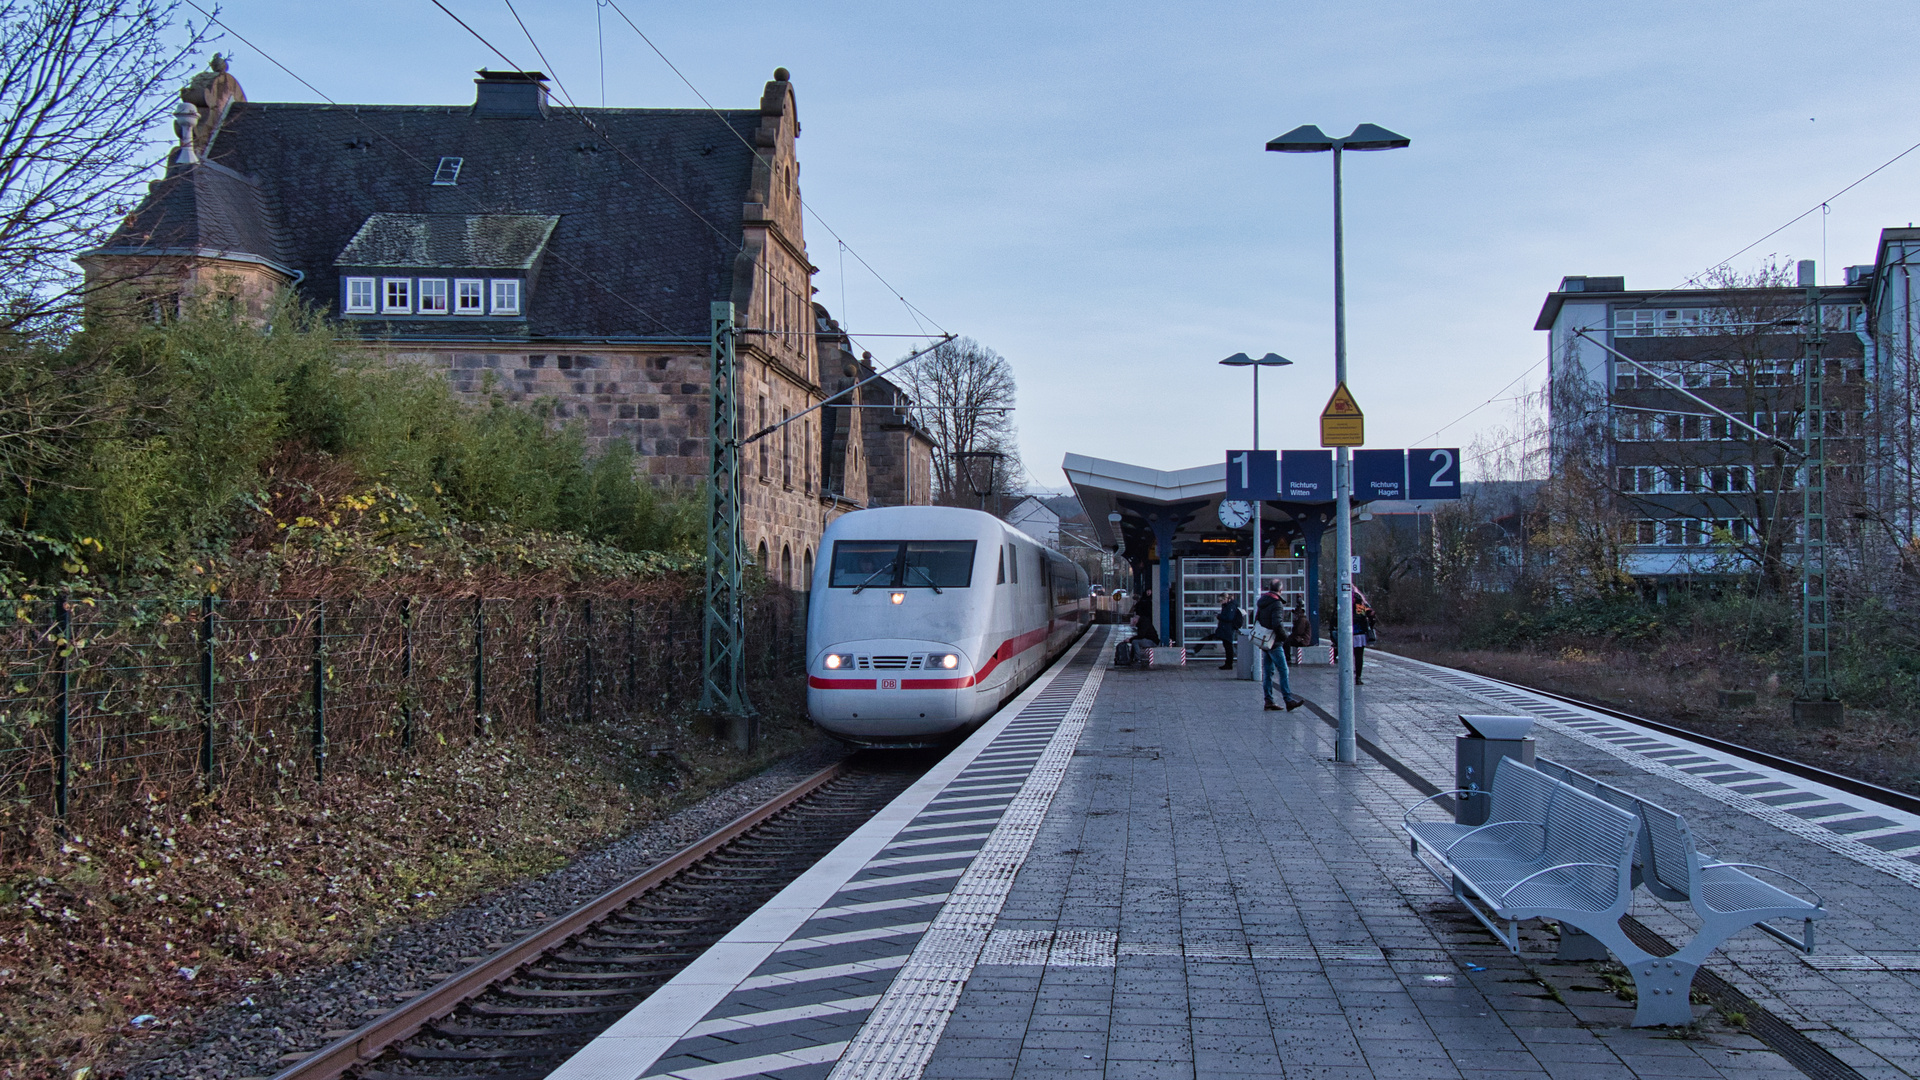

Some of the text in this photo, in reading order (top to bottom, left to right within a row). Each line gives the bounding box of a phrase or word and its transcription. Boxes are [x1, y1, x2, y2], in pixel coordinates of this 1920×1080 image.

[1232, 451, 1248, 489] 1
[1428, 449, 1454, 487] 2
[1290, 481, 1318, 490] Richtung
[1370, 481, 1399, 489] Richtung
[1378, 489, 1399, 497] Hagen
[1352, 564, 1358, 572] 8
[883, 680, 895, 688] DB
